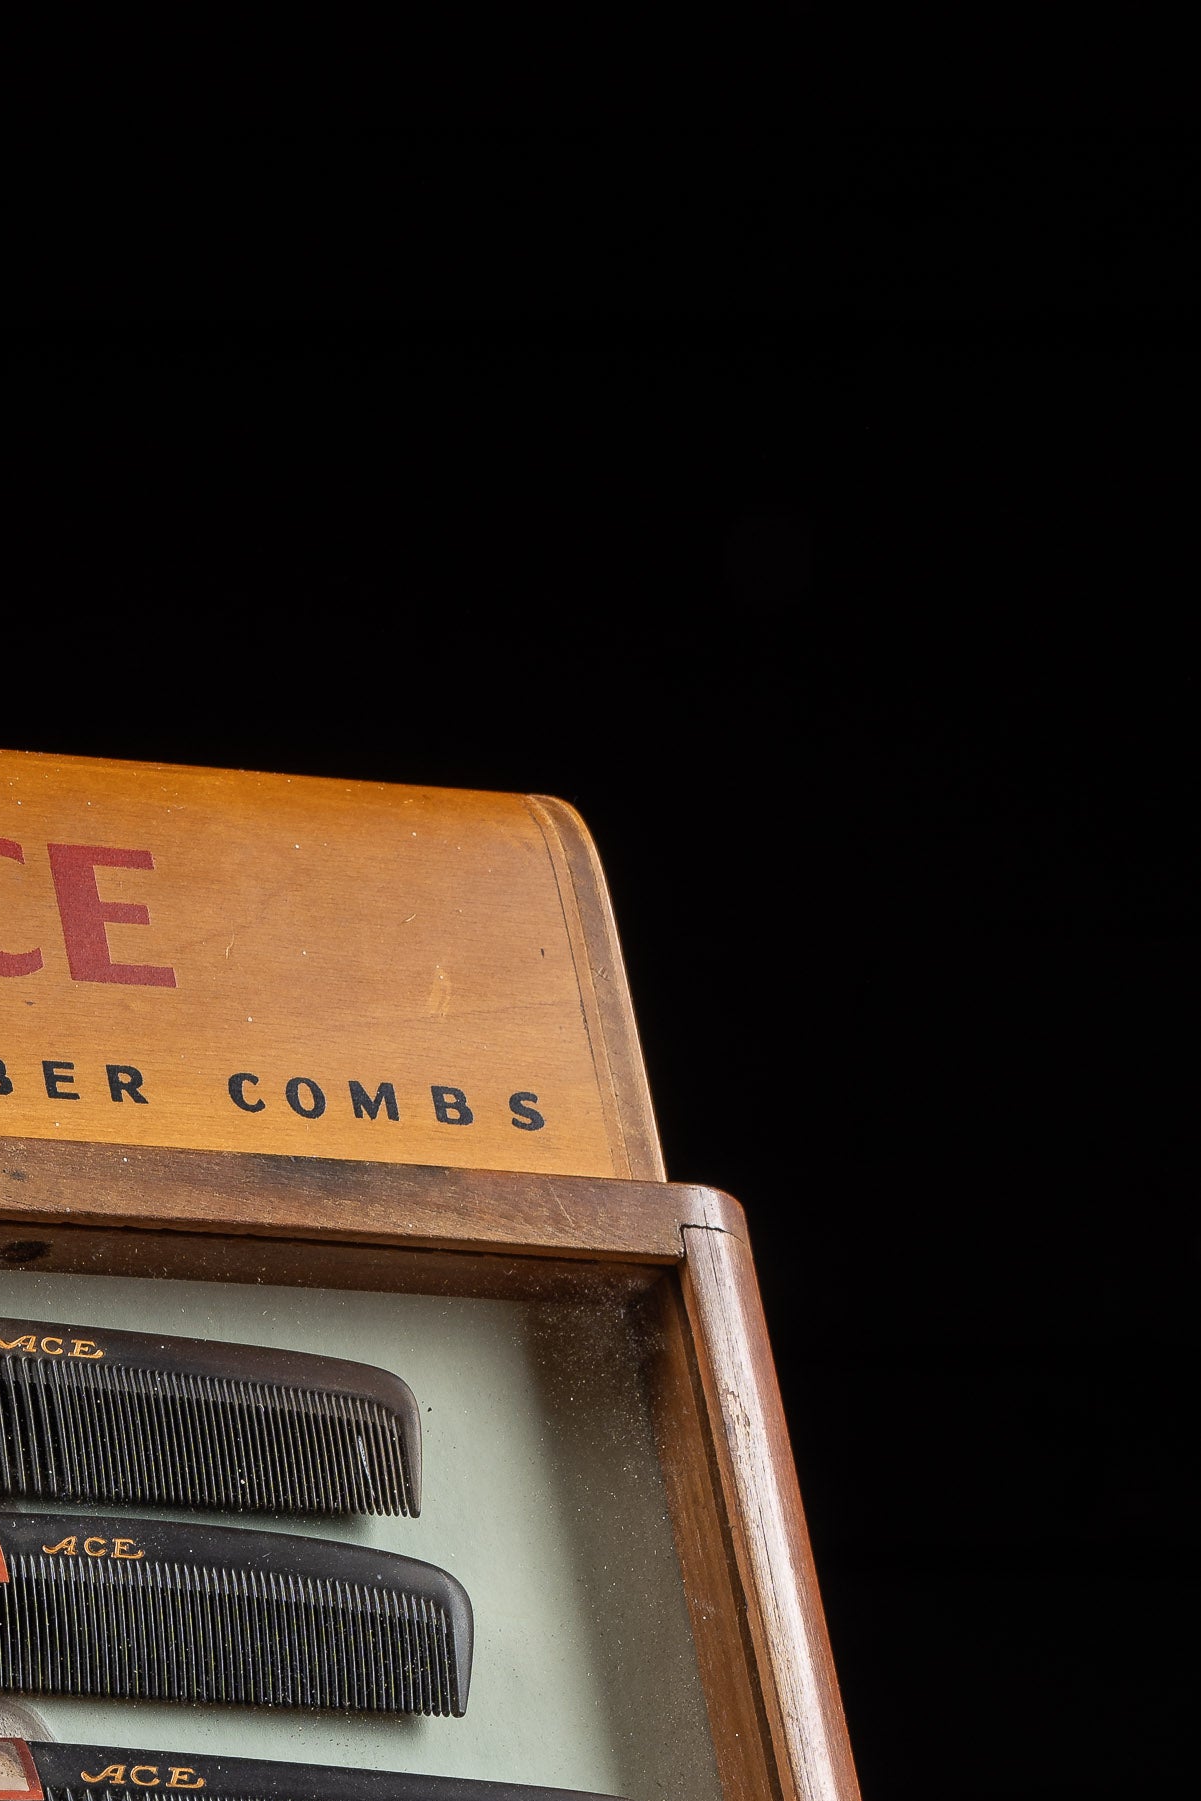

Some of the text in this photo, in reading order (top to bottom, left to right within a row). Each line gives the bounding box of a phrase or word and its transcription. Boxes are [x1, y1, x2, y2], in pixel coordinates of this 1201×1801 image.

[227, 1071, 546, 1131] COMBS
[42, 1535, 145, 1560] ACE
[81, 1763, 206, 1790] ACE
